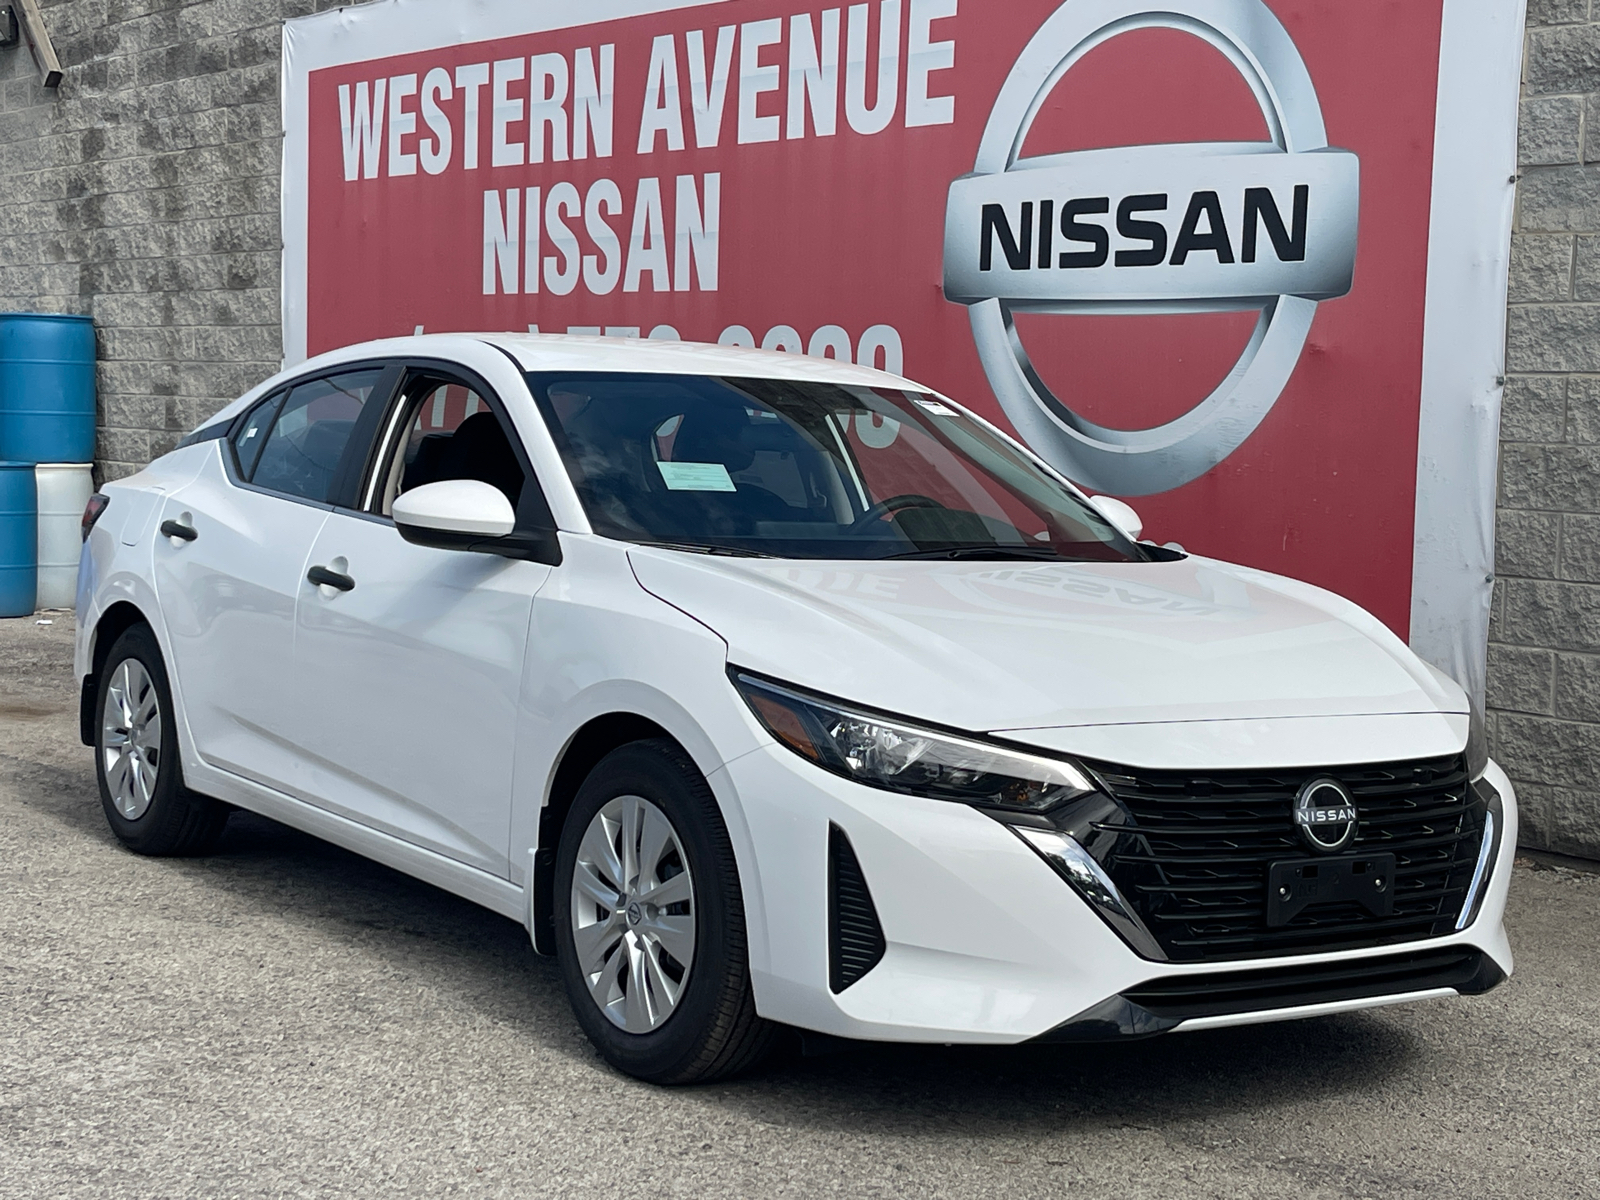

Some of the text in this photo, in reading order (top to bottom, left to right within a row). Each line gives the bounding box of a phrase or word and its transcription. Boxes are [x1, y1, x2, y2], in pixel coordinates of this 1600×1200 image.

[338, 0, 957, 181] WESTERN AVENUE
[483, 172, 721, 295] NISSAN
[979, 184, 1309, 271] NISSAN
[1298, 808, 1356, 822] NISSAN
